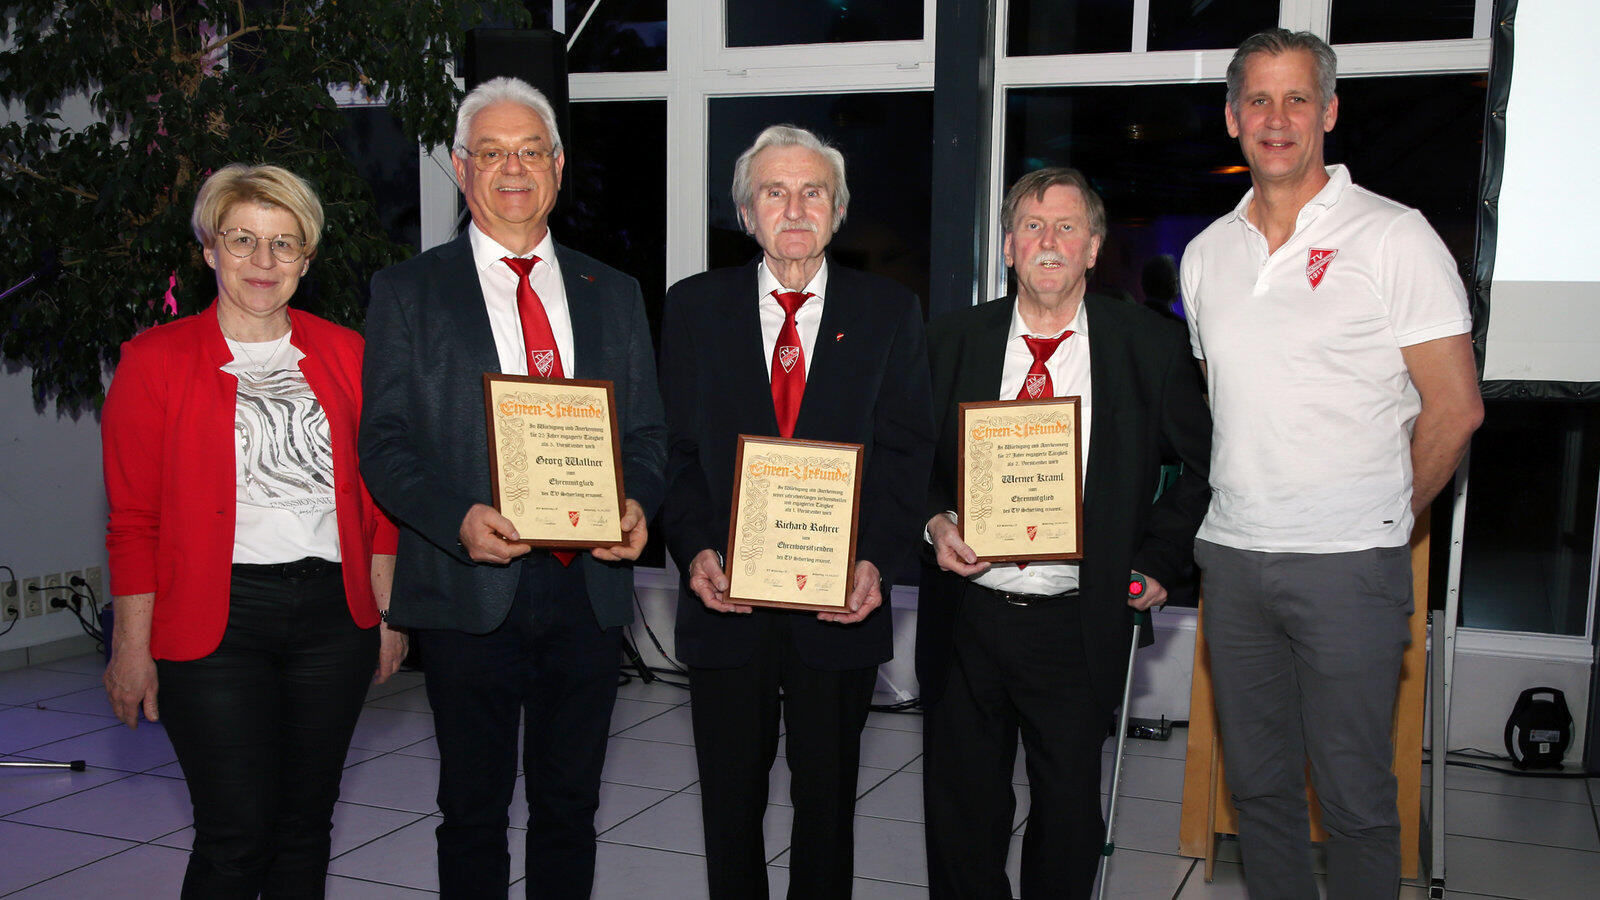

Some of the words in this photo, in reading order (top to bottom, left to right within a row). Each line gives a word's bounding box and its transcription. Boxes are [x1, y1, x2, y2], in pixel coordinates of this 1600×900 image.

[1311, 252, 1322, 262] TV
[500, 400, 602, 419] Ehren-Urkunde
[972, 421, 1068, 440] Ehren-Urkunde
[536, 455, 563, 467] Georg
[565, 456, 603, 467] Wallner
[750, 462, 849, 481] Ehren-Urkunde
[549, 478, 594, 487] Ehrenmitglied
[1001, 474, 1034, 484] Werner
[1036, 473, 1064, 483] Kraml
[775, 519, 807, 531] Richard
[810, 522, 840, 533] Rohrer
[777, 541, 834, 553] Ehrenvorsitzenden
